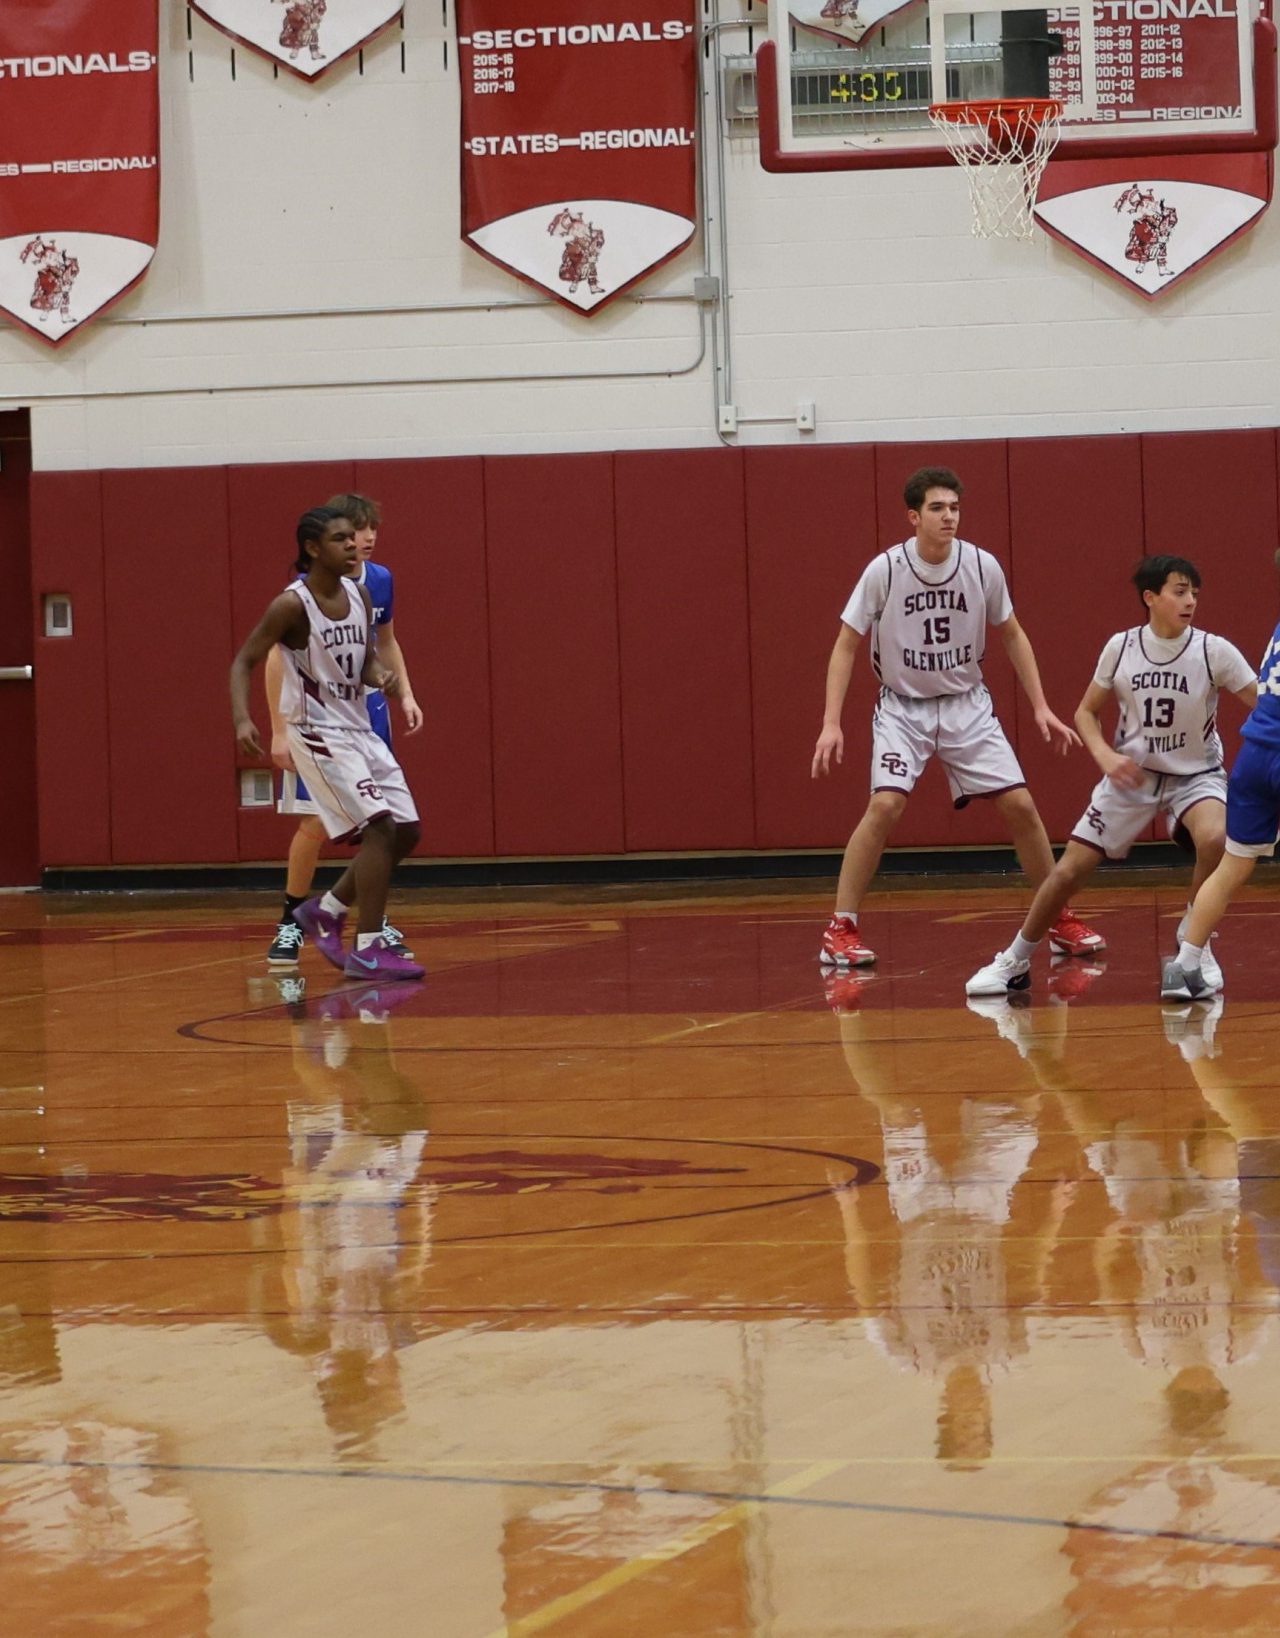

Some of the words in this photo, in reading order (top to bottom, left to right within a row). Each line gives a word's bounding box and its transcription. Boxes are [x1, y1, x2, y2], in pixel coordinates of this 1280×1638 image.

[472, 20, 685, 50] SECTIONALS
[1141, 24, 1181, 36] 2011-12
[1140, 38, 1183, 50] 2012-13
[0, 51, 151, 78] TIONALS
[473, 54, 514, 67] 2015-16
[1140, 52, 1183, 65] 2013-14
[473, 67, 514, 80] 2016-17
[1140, 66, 1183, 79] 2015-16
[474, 81, 515, 94] 2017-18
[1153, 106, 1242, 121] REGIONA
[904, 589, 969, 616] SCOTIA
[923, 616, 951, 645] 15
[903, 643, 973, 672] GLENVILLE
[1131, 671, 1190, 695] SCOTIA
[1142, 698, 1176, 728] 13
